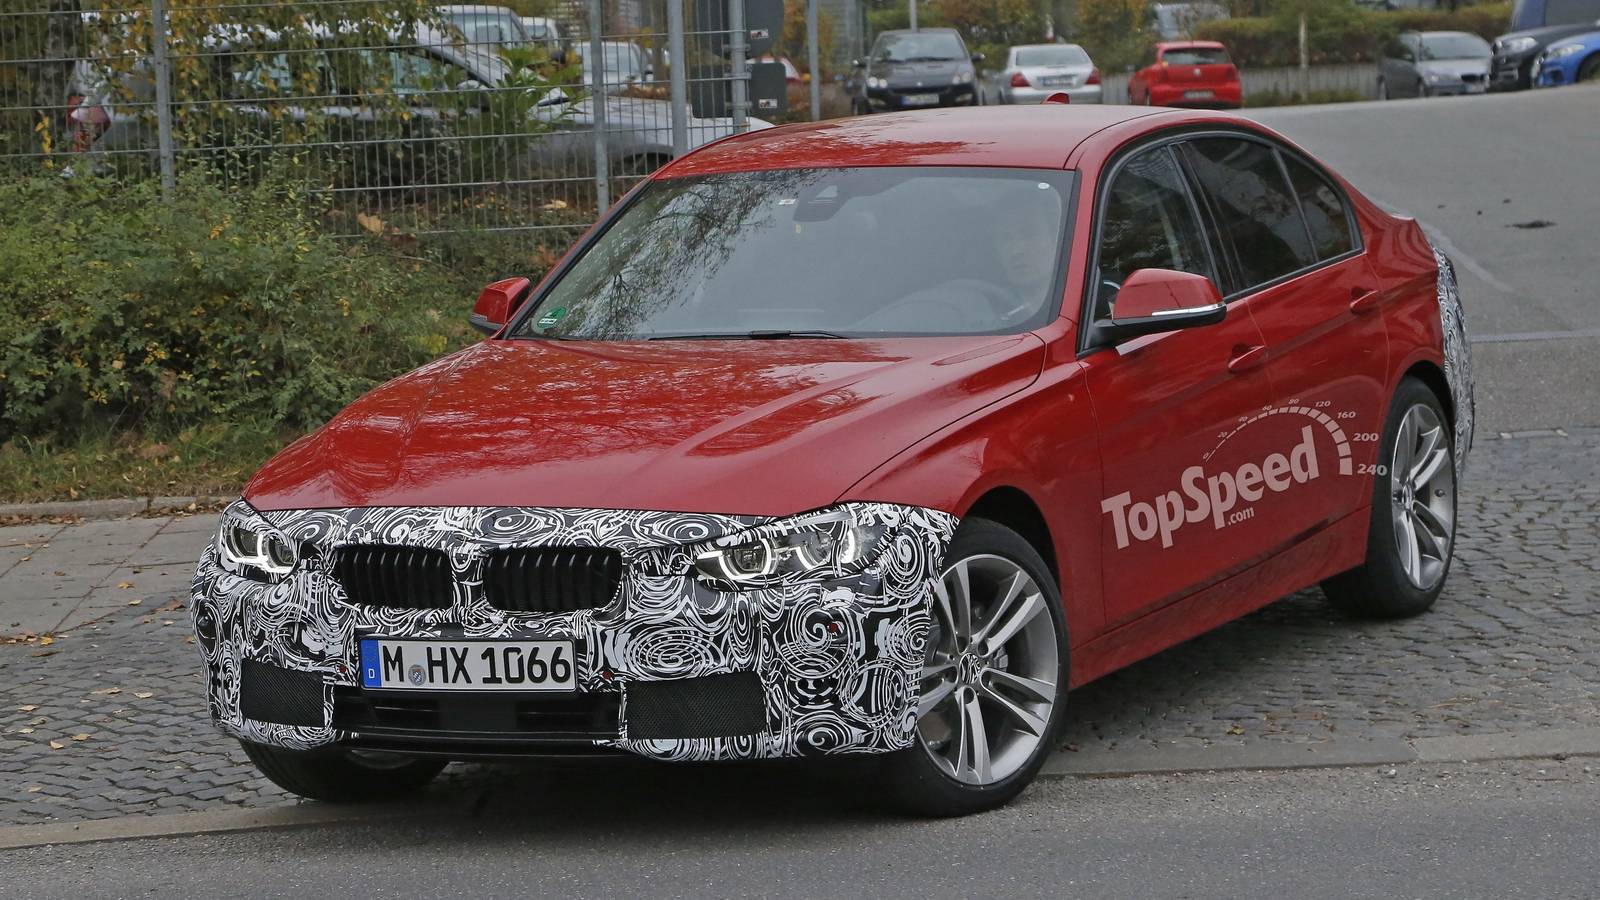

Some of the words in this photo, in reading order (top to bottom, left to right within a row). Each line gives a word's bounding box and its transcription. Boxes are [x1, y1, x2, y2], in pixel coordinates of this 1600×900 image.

[368, 668, 375, 679] D
[381, 645, 405, 683] M
[426, 646, 472, 684] HX
[480, 646, 571, 685] 1066
